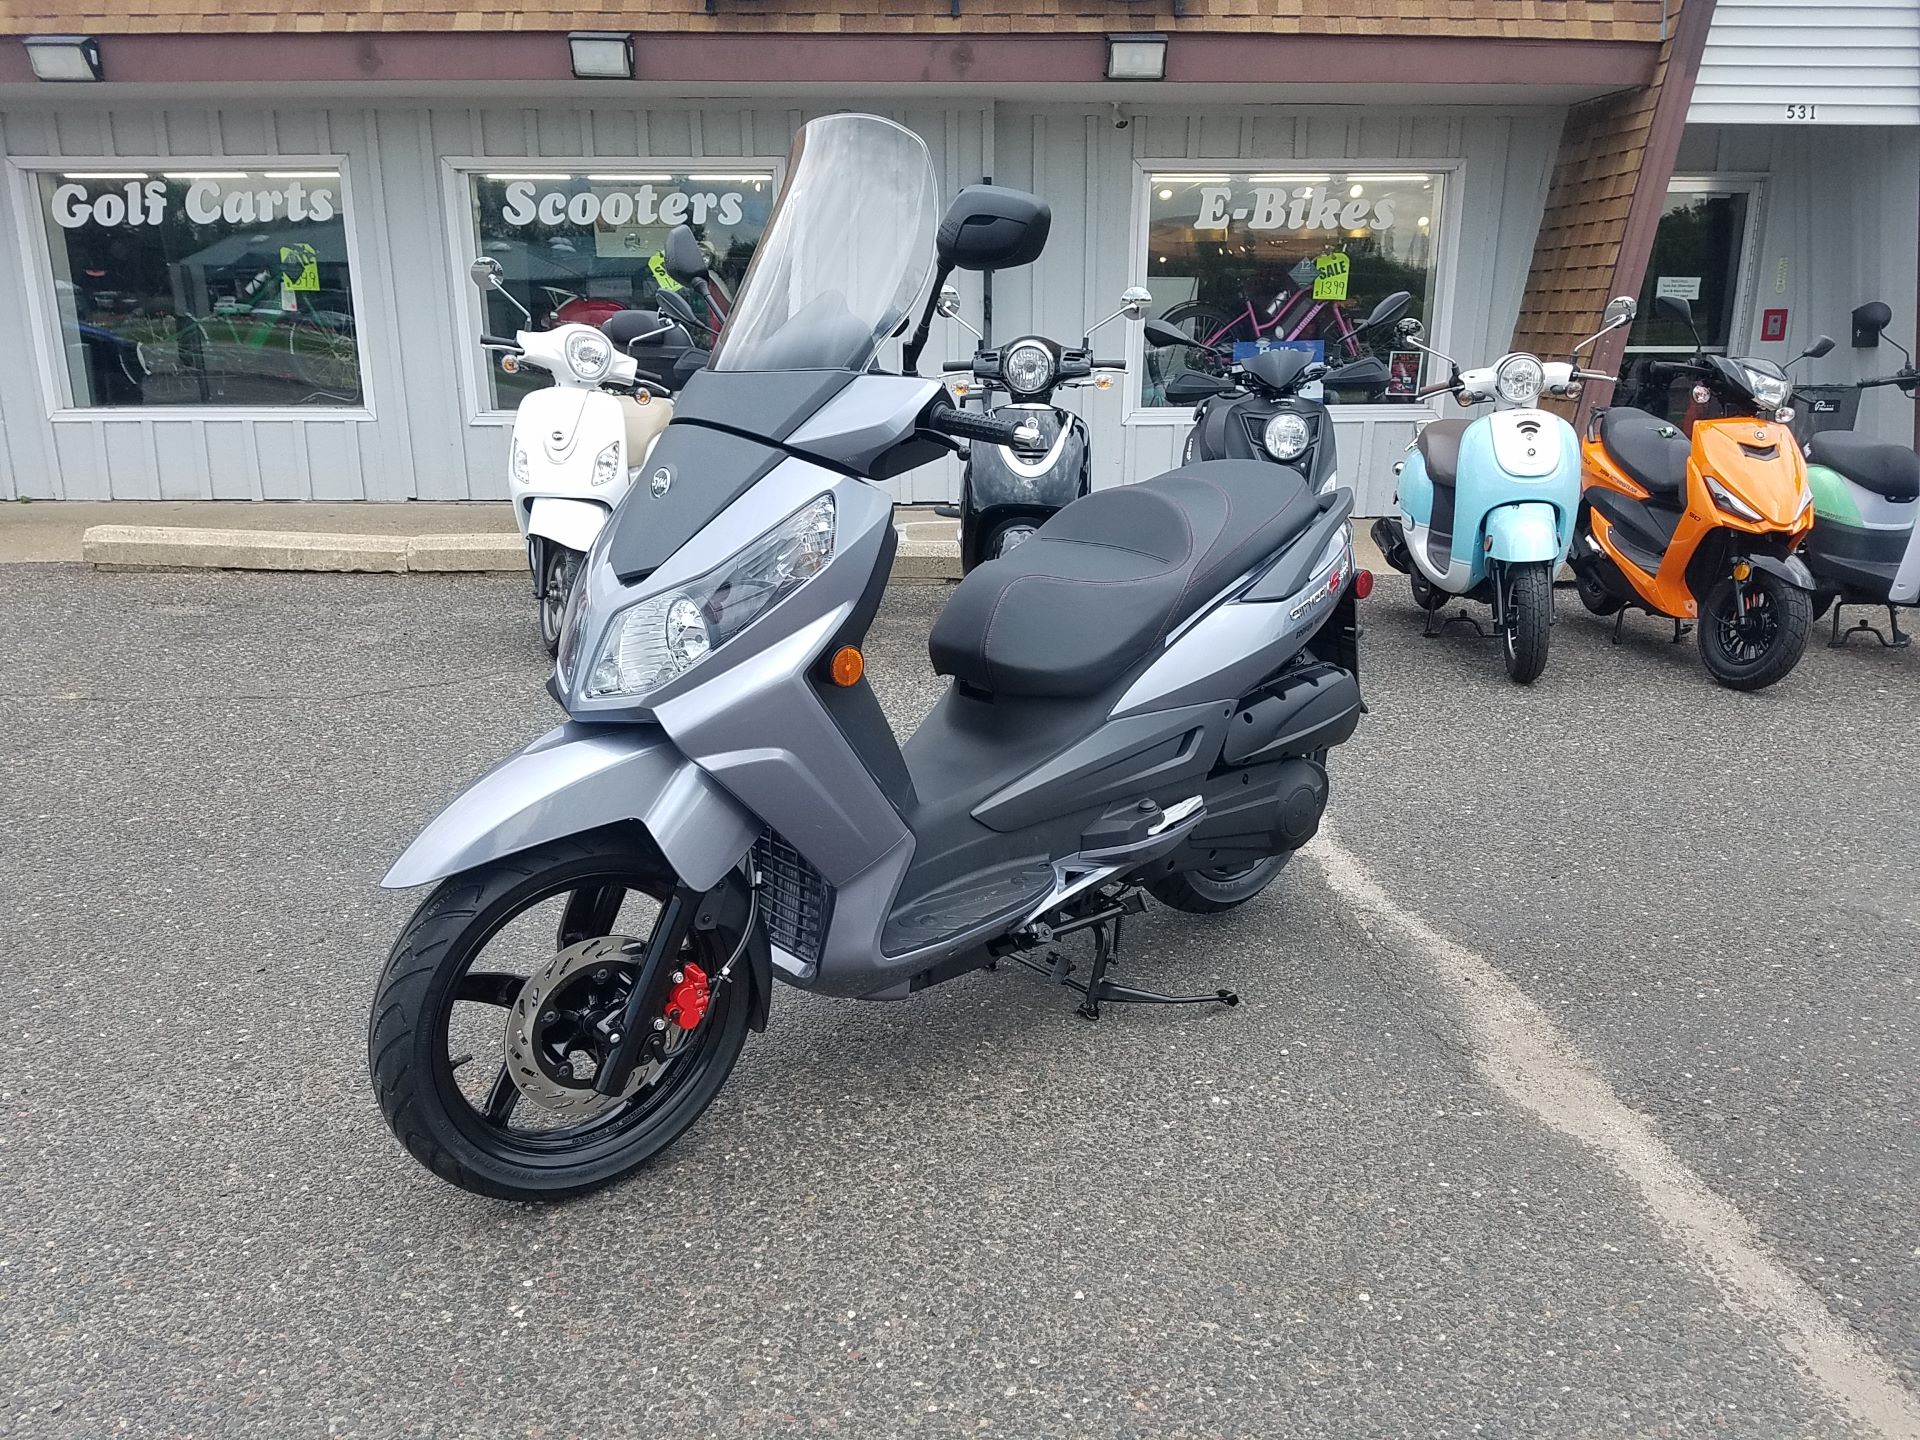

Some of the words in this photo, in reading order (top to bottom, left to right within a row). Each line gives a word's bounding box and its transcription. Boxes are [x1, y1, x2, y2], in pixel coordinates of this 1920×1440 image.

[1786, 104, 1817, 120] 531
[51, 180, 168, 229] Golf
[184, 181, 335, 225] Carts
[501, 180, 744, 227] Scooters
[1193, 186, 1397, 231] E-Bikes
[1317, 260, 1347, 280] SALE
